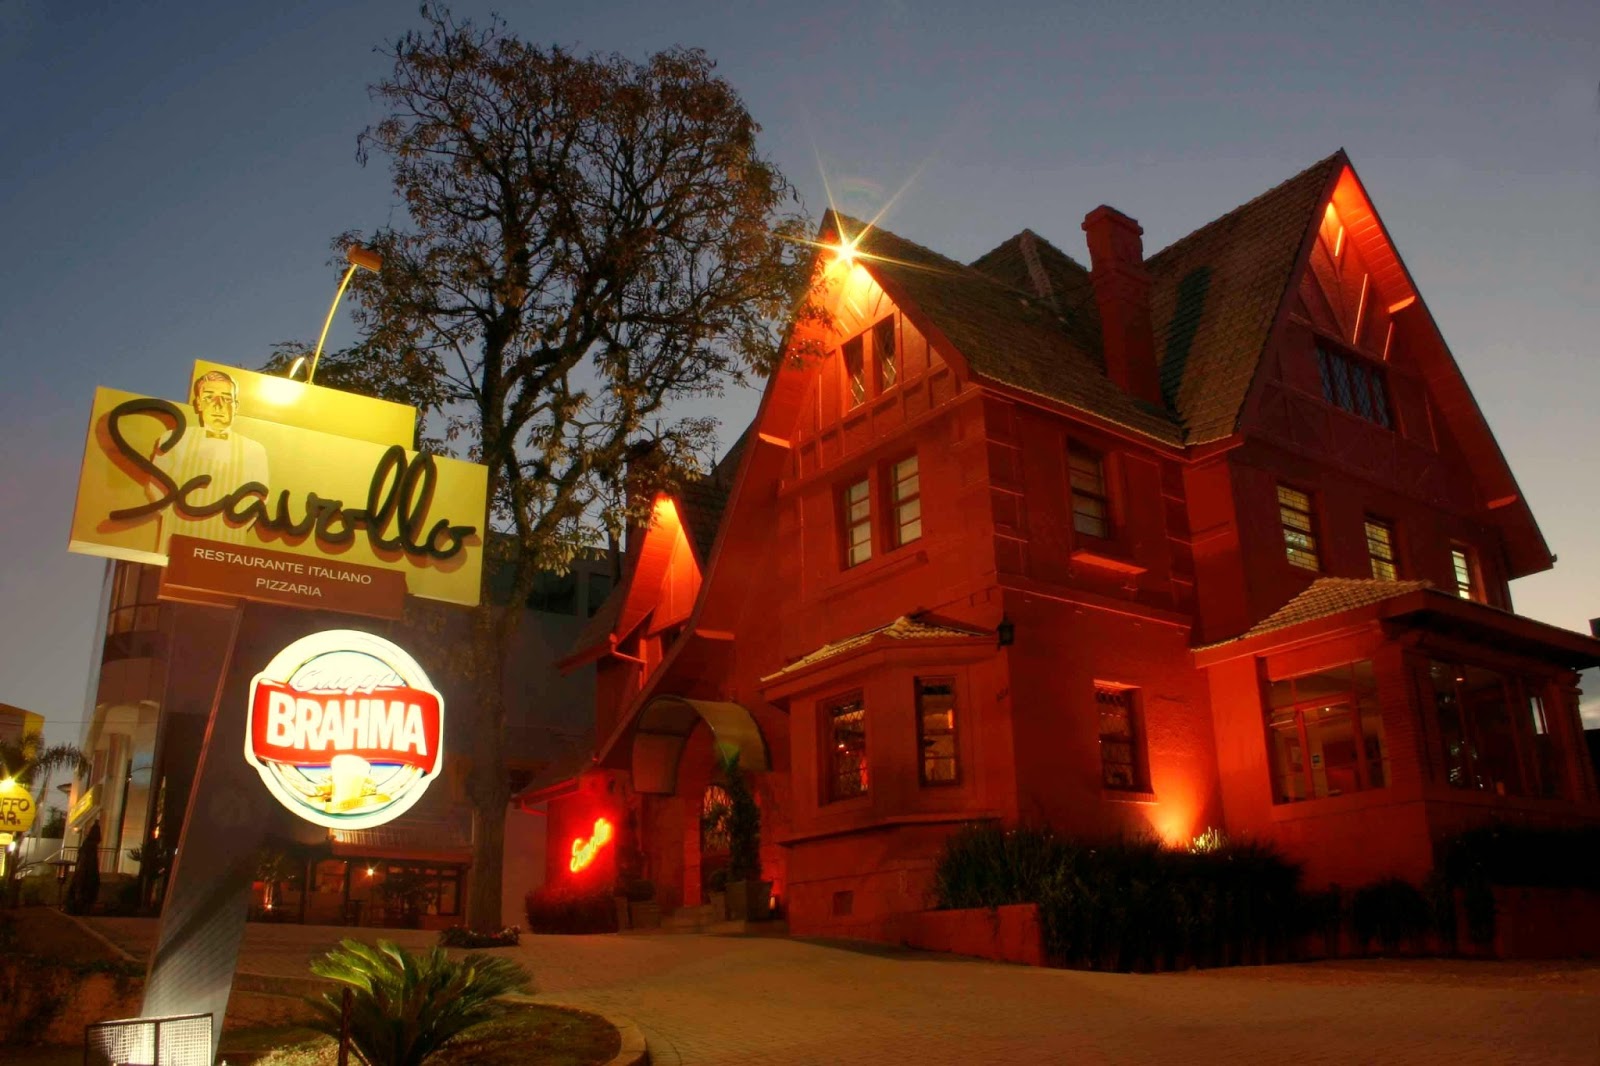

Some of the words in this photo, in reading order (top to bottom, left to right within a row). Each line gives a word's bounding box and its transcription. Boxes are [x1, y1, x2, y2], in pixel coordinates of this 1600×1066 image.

[108, 398, 476, 560] Scavollo
[193, 548, 304, 574] RESTAURANTE
[308, 566, 372, 585] ITALIANO
[255, 577, 322, 597] PIZZARIA
[266, 690, 428, 757] BRAHMA
[0, 797, 30, 812] FFO
